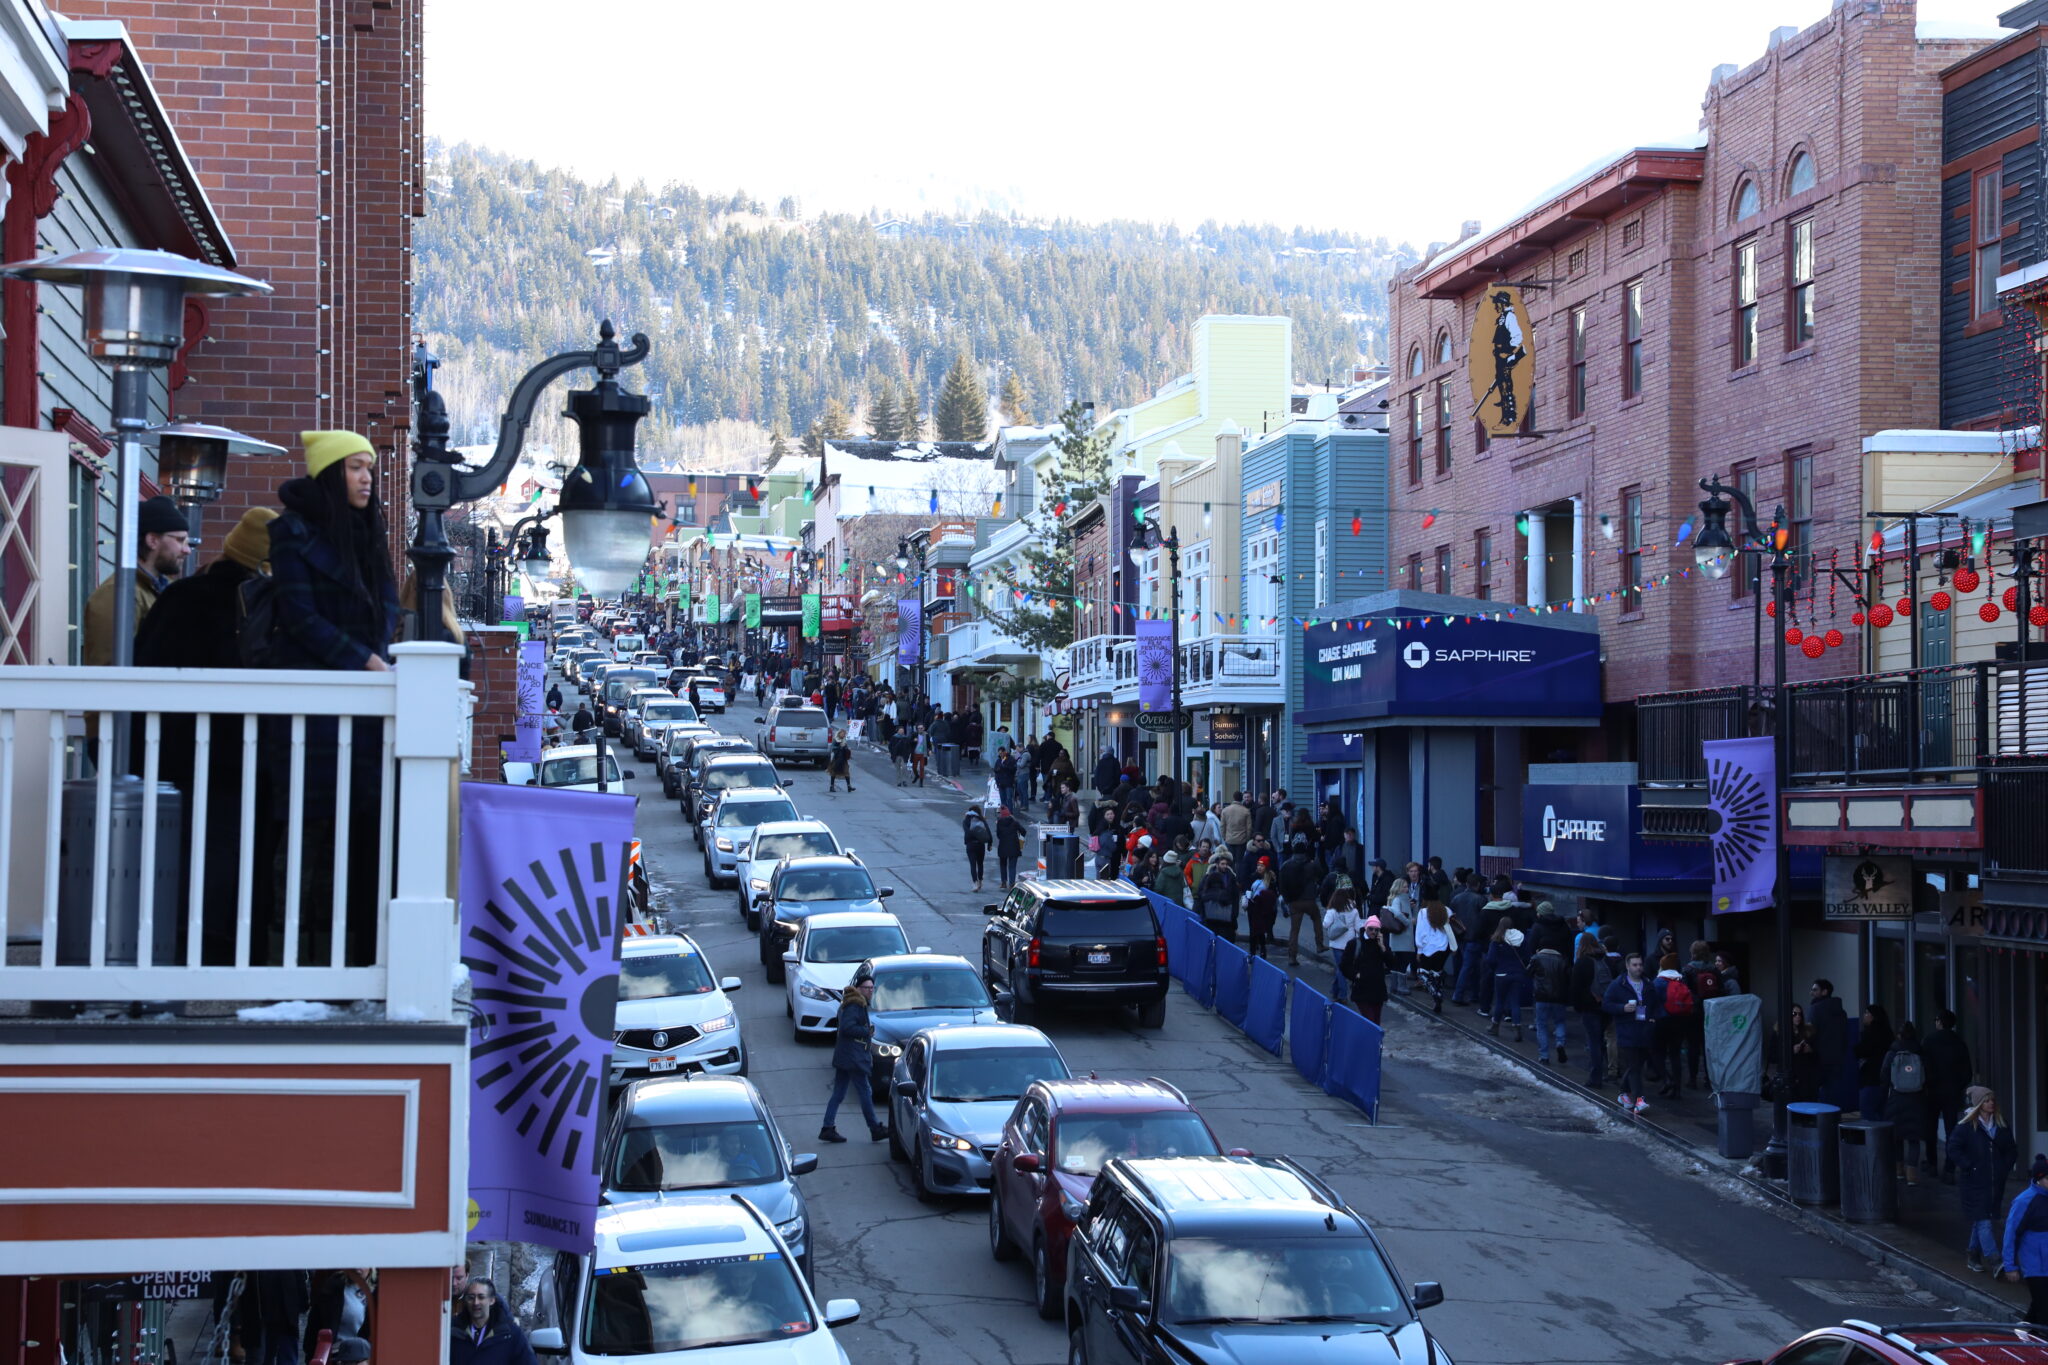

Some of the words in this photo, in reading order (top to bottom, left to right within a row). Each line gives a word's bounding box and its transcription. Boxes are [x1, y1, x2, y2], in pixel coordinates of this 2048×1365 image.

[1319, 645, 1341, 663] CHASE
[1342, 638, 1377, 659] SAPPHIRE
[1332, 666, 1343, 682] ON
[1344, 663, 1361, 681] MAIN
[1557, 819, 1606, 842] SAPPHIRE
[1826, 903, 1860, 914] DEER
[1862, 903, 1910, 914] VALLEY
[634, 1262, 688, 1271] OFFICIAL
[696, 1256, 742, 1265] VEHICLE
[131, 1271, 175, 1284] OPEN
[180, 1270, 211, 1283] FOR
[144, 1284, 199, 1299] LUNCH
